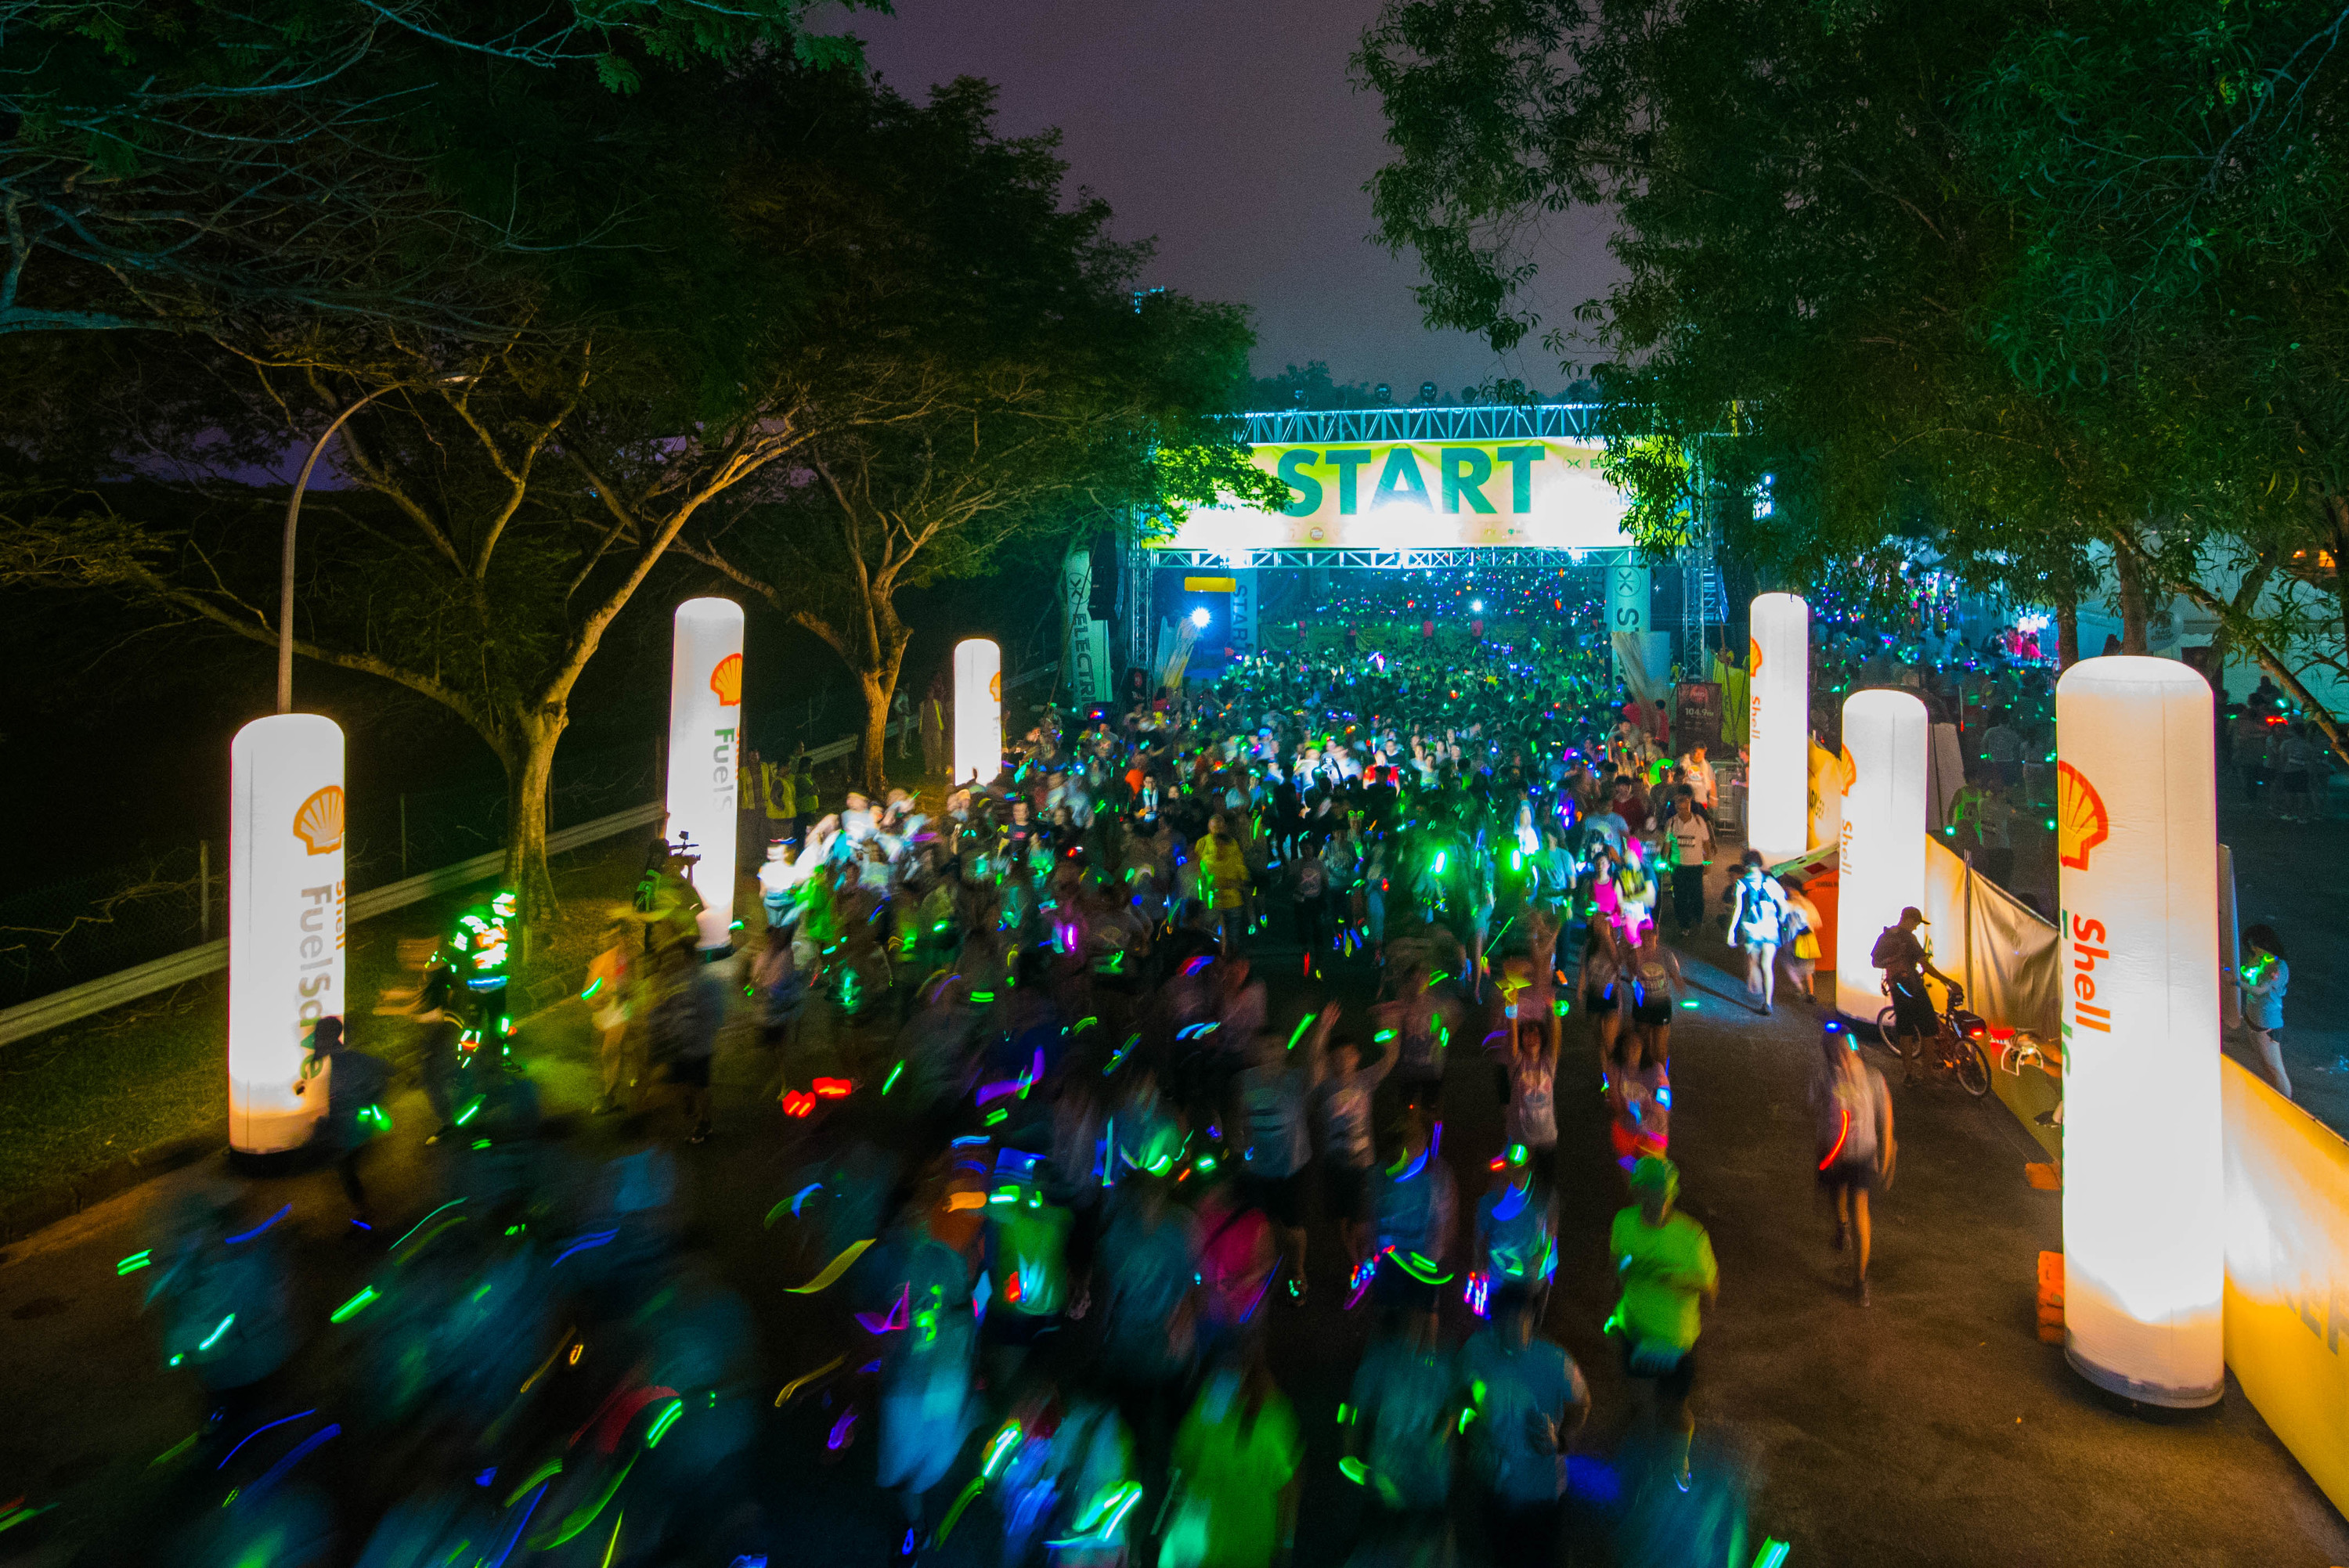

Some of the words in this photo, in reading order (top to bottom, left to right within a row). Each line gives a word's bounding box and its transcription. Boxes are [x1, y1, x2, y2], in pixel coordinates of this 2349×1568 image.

[1277, 445, 1546, 518] START
[1233, 584, 1248, 655] START
[1751, 695, 1761, 740] Shell
[1842, 819, 1853, 875] Shell
[2073, 913, 2111, 1033] Shell
